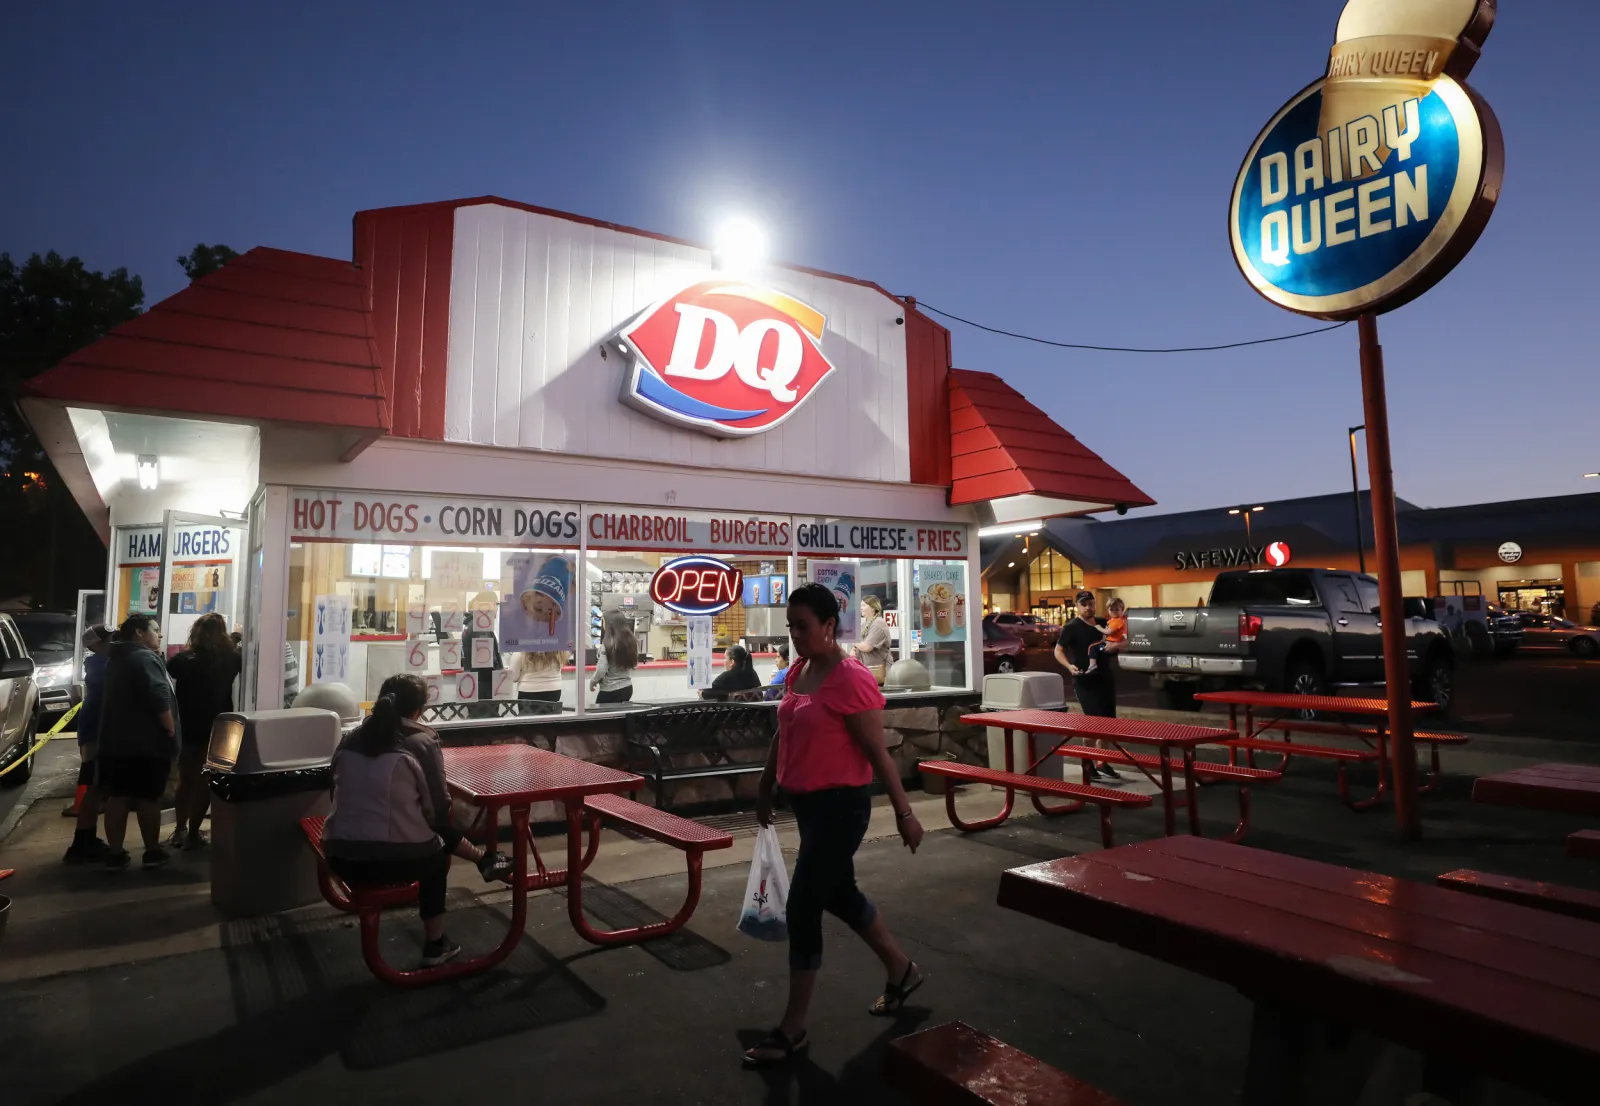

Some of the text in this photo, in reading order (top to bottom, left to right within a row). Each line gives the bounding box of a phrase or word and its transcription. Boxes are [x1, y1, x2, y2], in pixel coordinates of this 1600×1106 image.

[1370, 49, 1439, 79] QUEEN
[1260, 98, 1421, 207] DAIRY
[1260, 164, 1429, 267] QUEEN
[664, 302, 803, 402] DQ
[293, 498, 577, 538] HOT DOGS CORN DOGS
[588, 513, 790, 546] CHARBROIL BURGERS
[128, 530, 231, 558] HAMURGERS
[797, 523, 962, 552] GRILL CHEESE FRIES
[1174, 546, 1264, 571] SAFEWAY
[655, 569, 740, 601] OPEN
[923, 570, 943, 580] SHAKES
